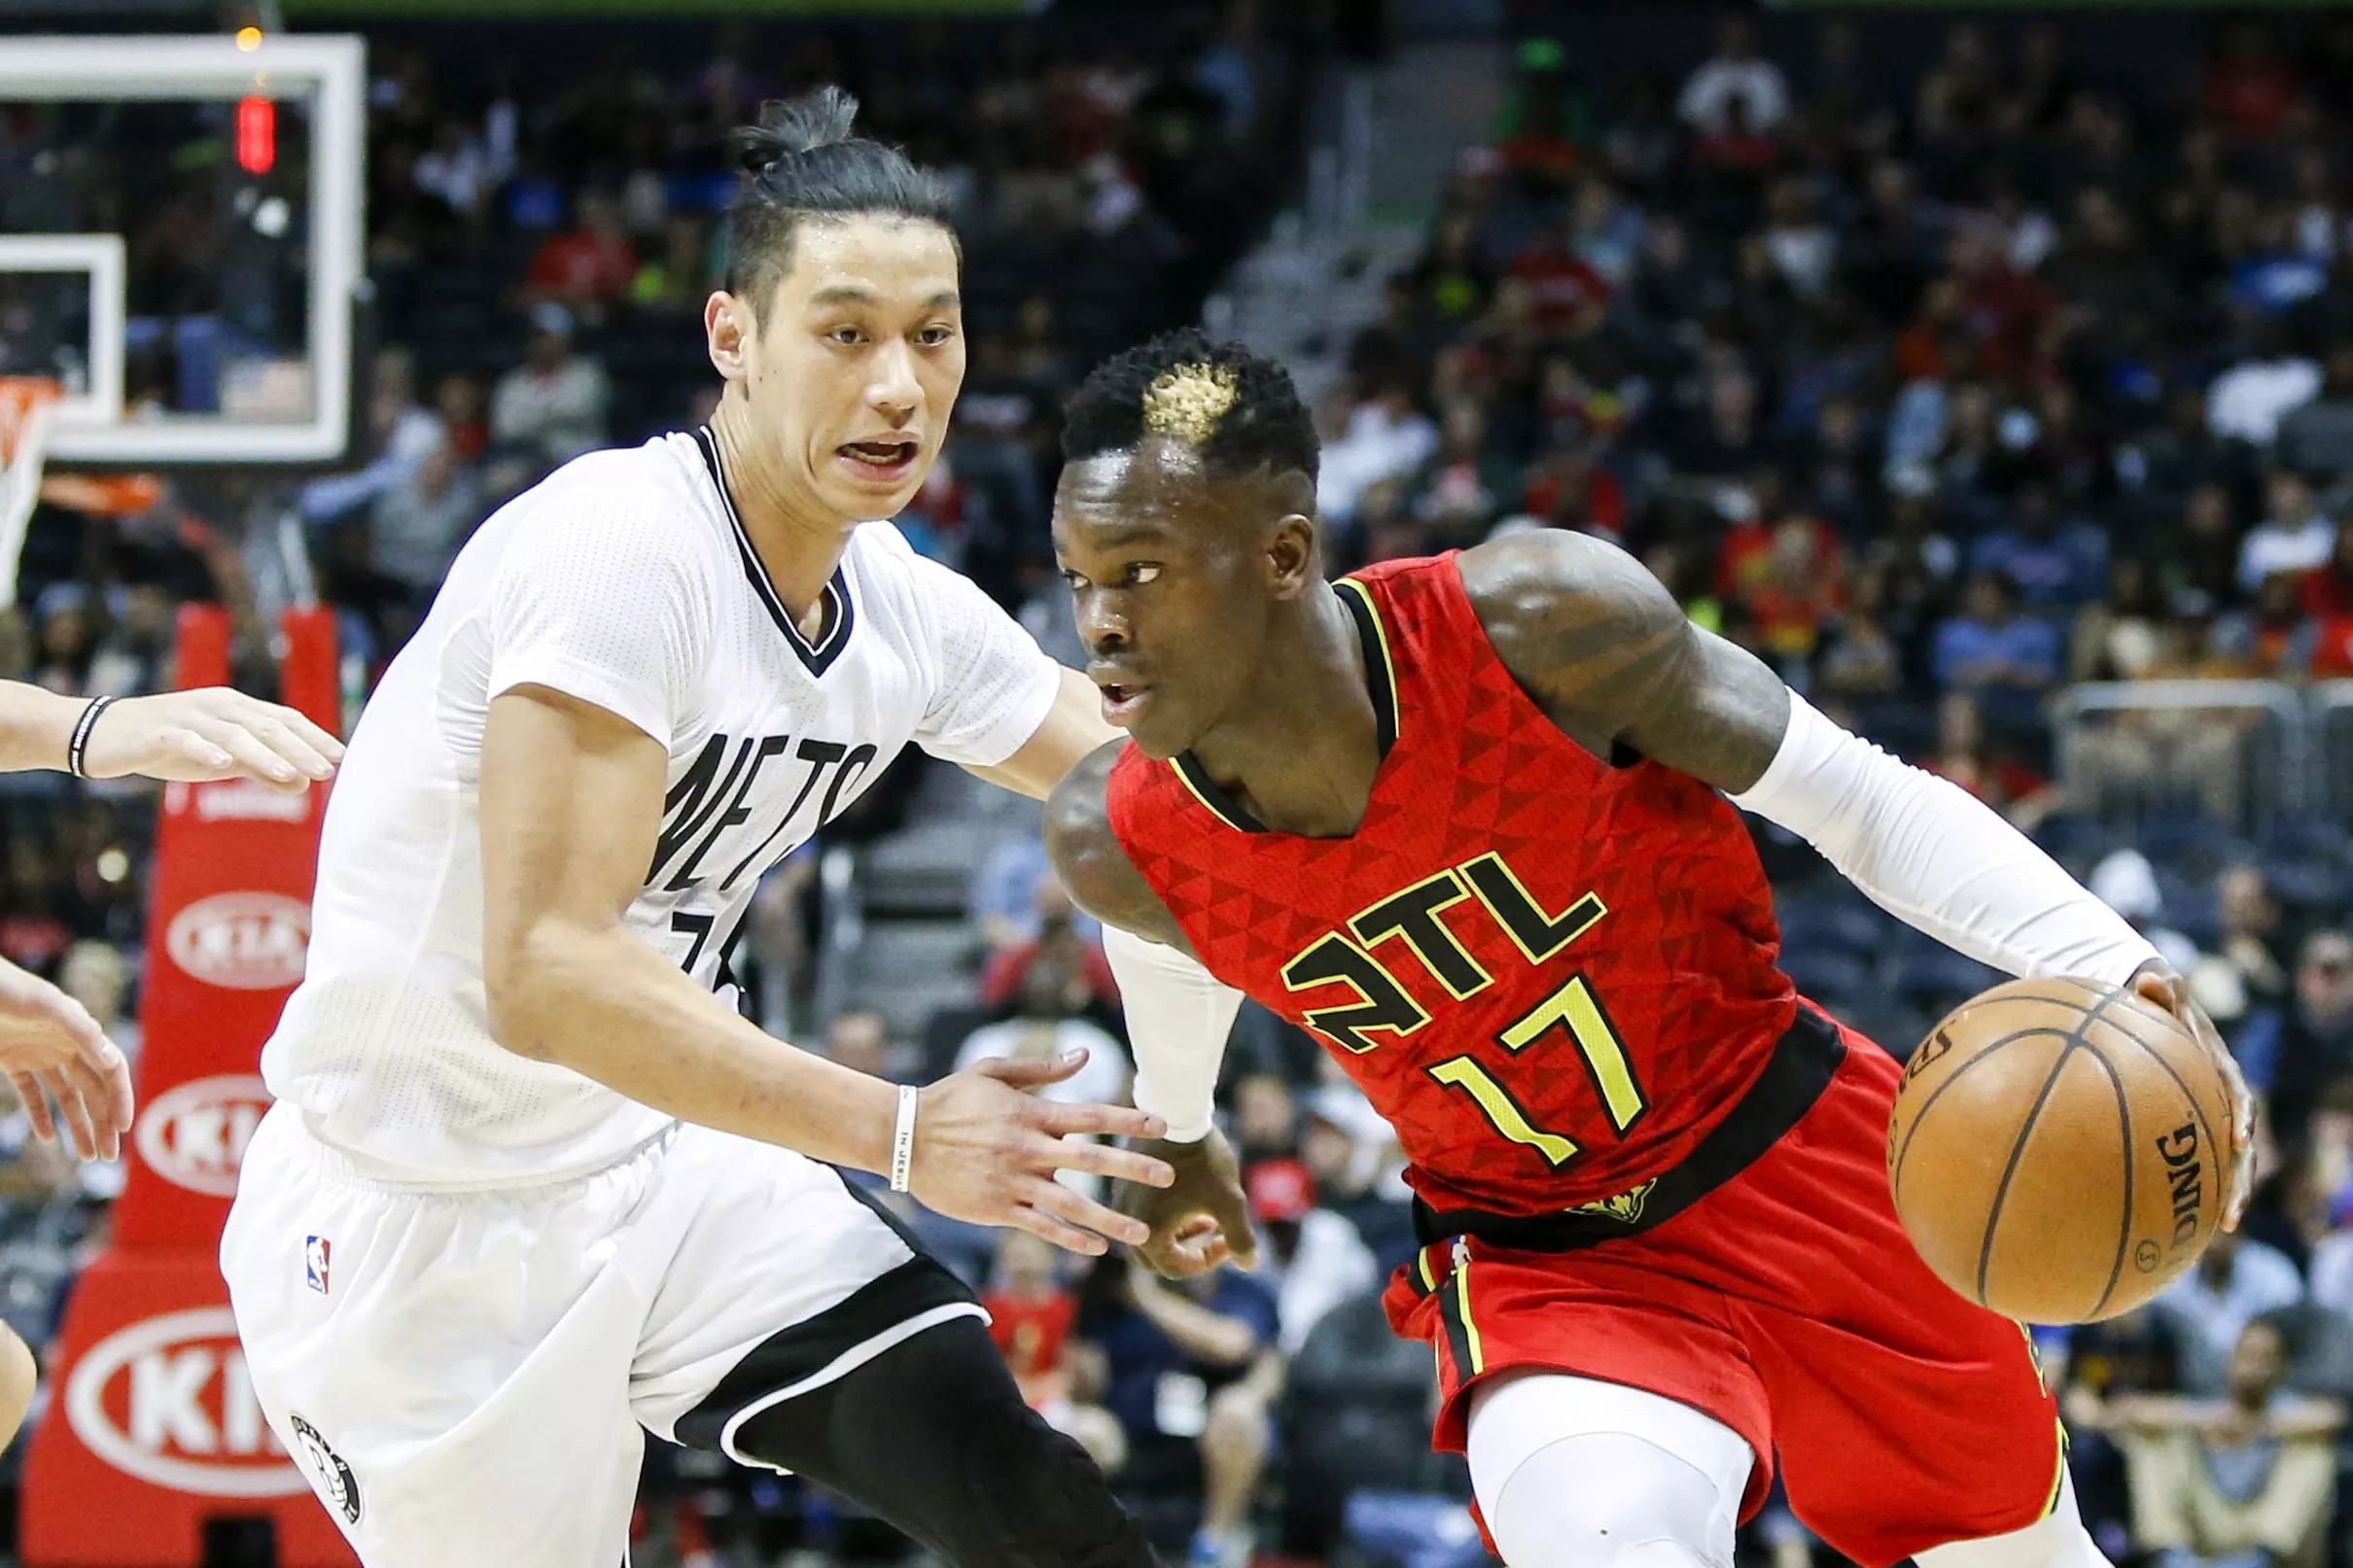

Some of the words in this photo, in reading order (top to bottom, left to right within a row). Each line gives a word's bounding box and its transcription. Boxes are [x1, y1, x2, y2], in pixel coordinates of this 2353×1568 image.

[644, 733, 877, 891] NETS
[1280, 851, 1609, 1054] ATL
[174, 1102, 256, 1172] KI
[1422, 972, 1650, 1171] 17
[2156, 1123, 2202, 1251] DING
[131, 1346, 292, 1456] KI
